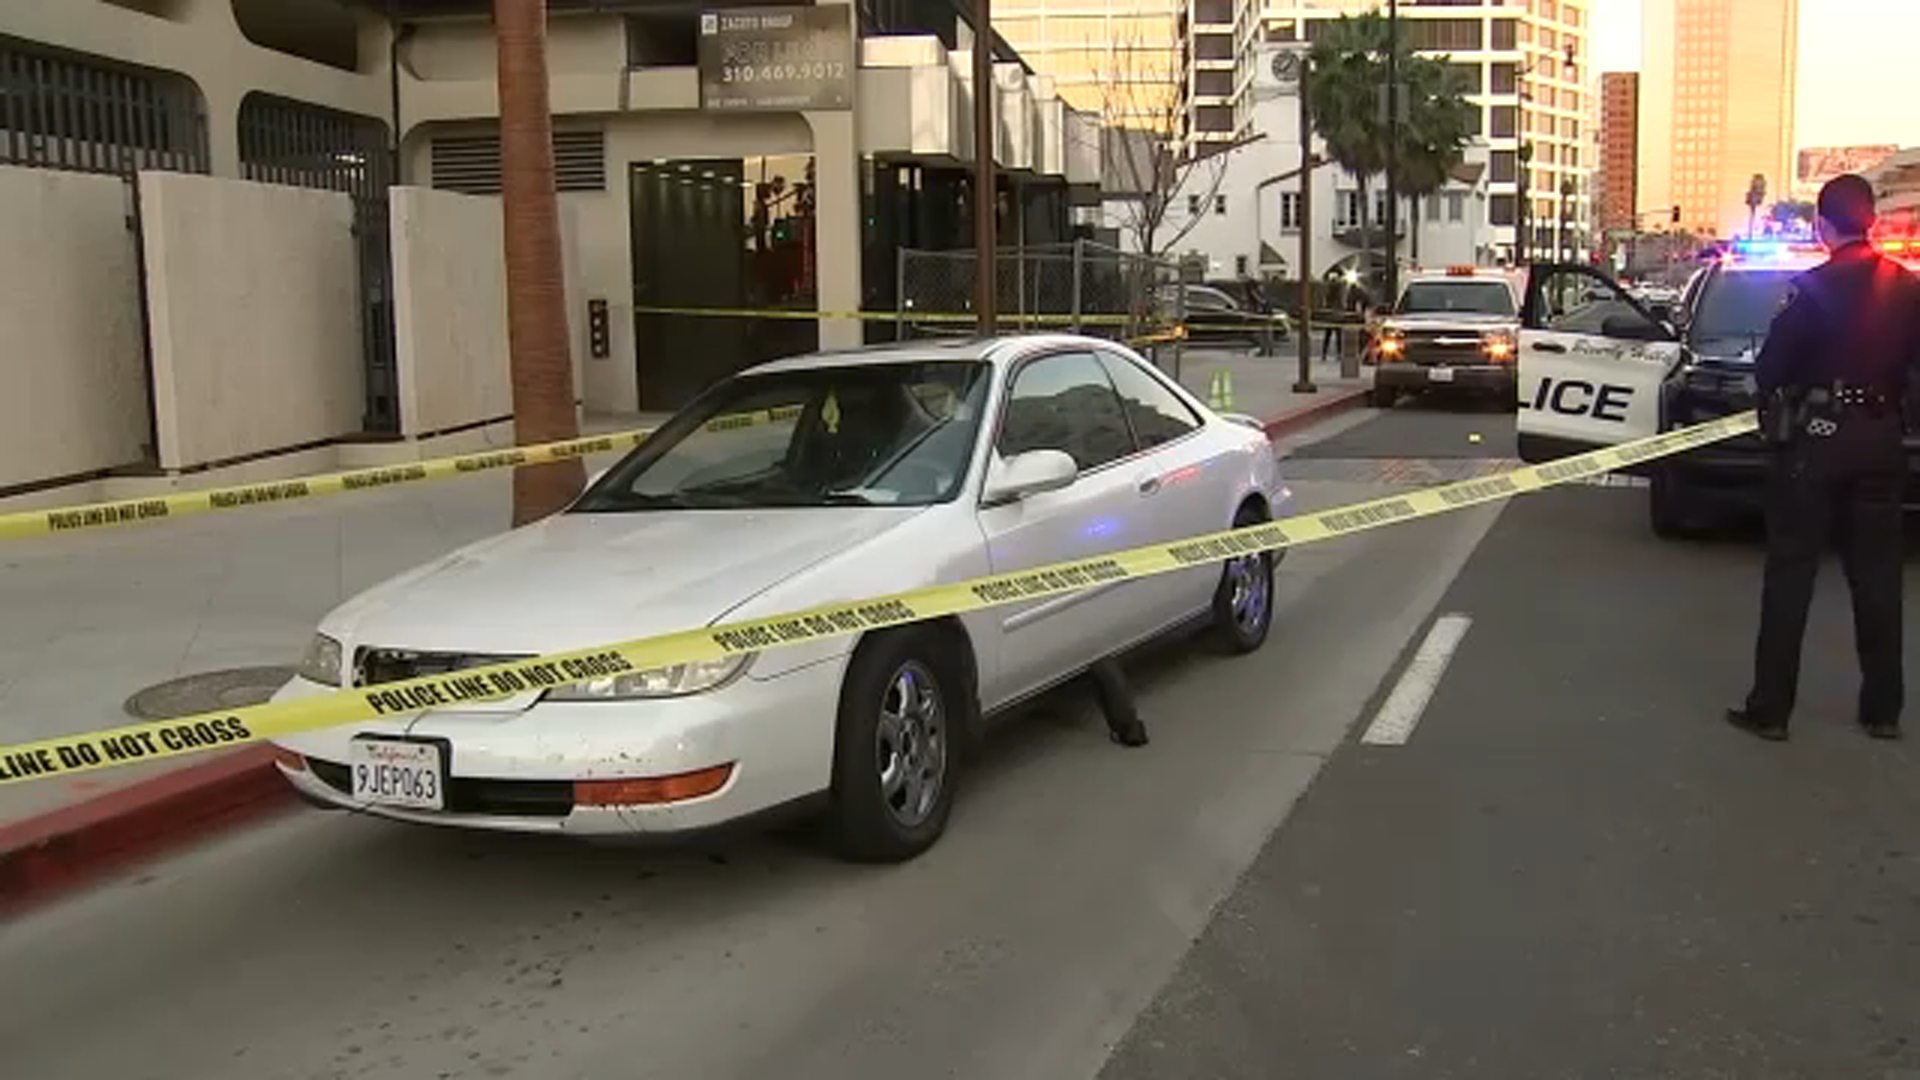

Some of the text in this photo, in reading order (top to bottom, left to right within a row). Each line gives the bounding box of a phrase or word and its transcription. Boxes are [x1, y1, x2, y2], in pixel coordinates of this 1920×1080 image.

[366, 651, 633, 715] POLICE LINE DO NOT CROSS
[56, 742, 102, 769] DO
[100, 731, 159, 761] NOT
[159, 716, 251, 751] CROSS
[357, 764, 436, 799] 9JEP063
